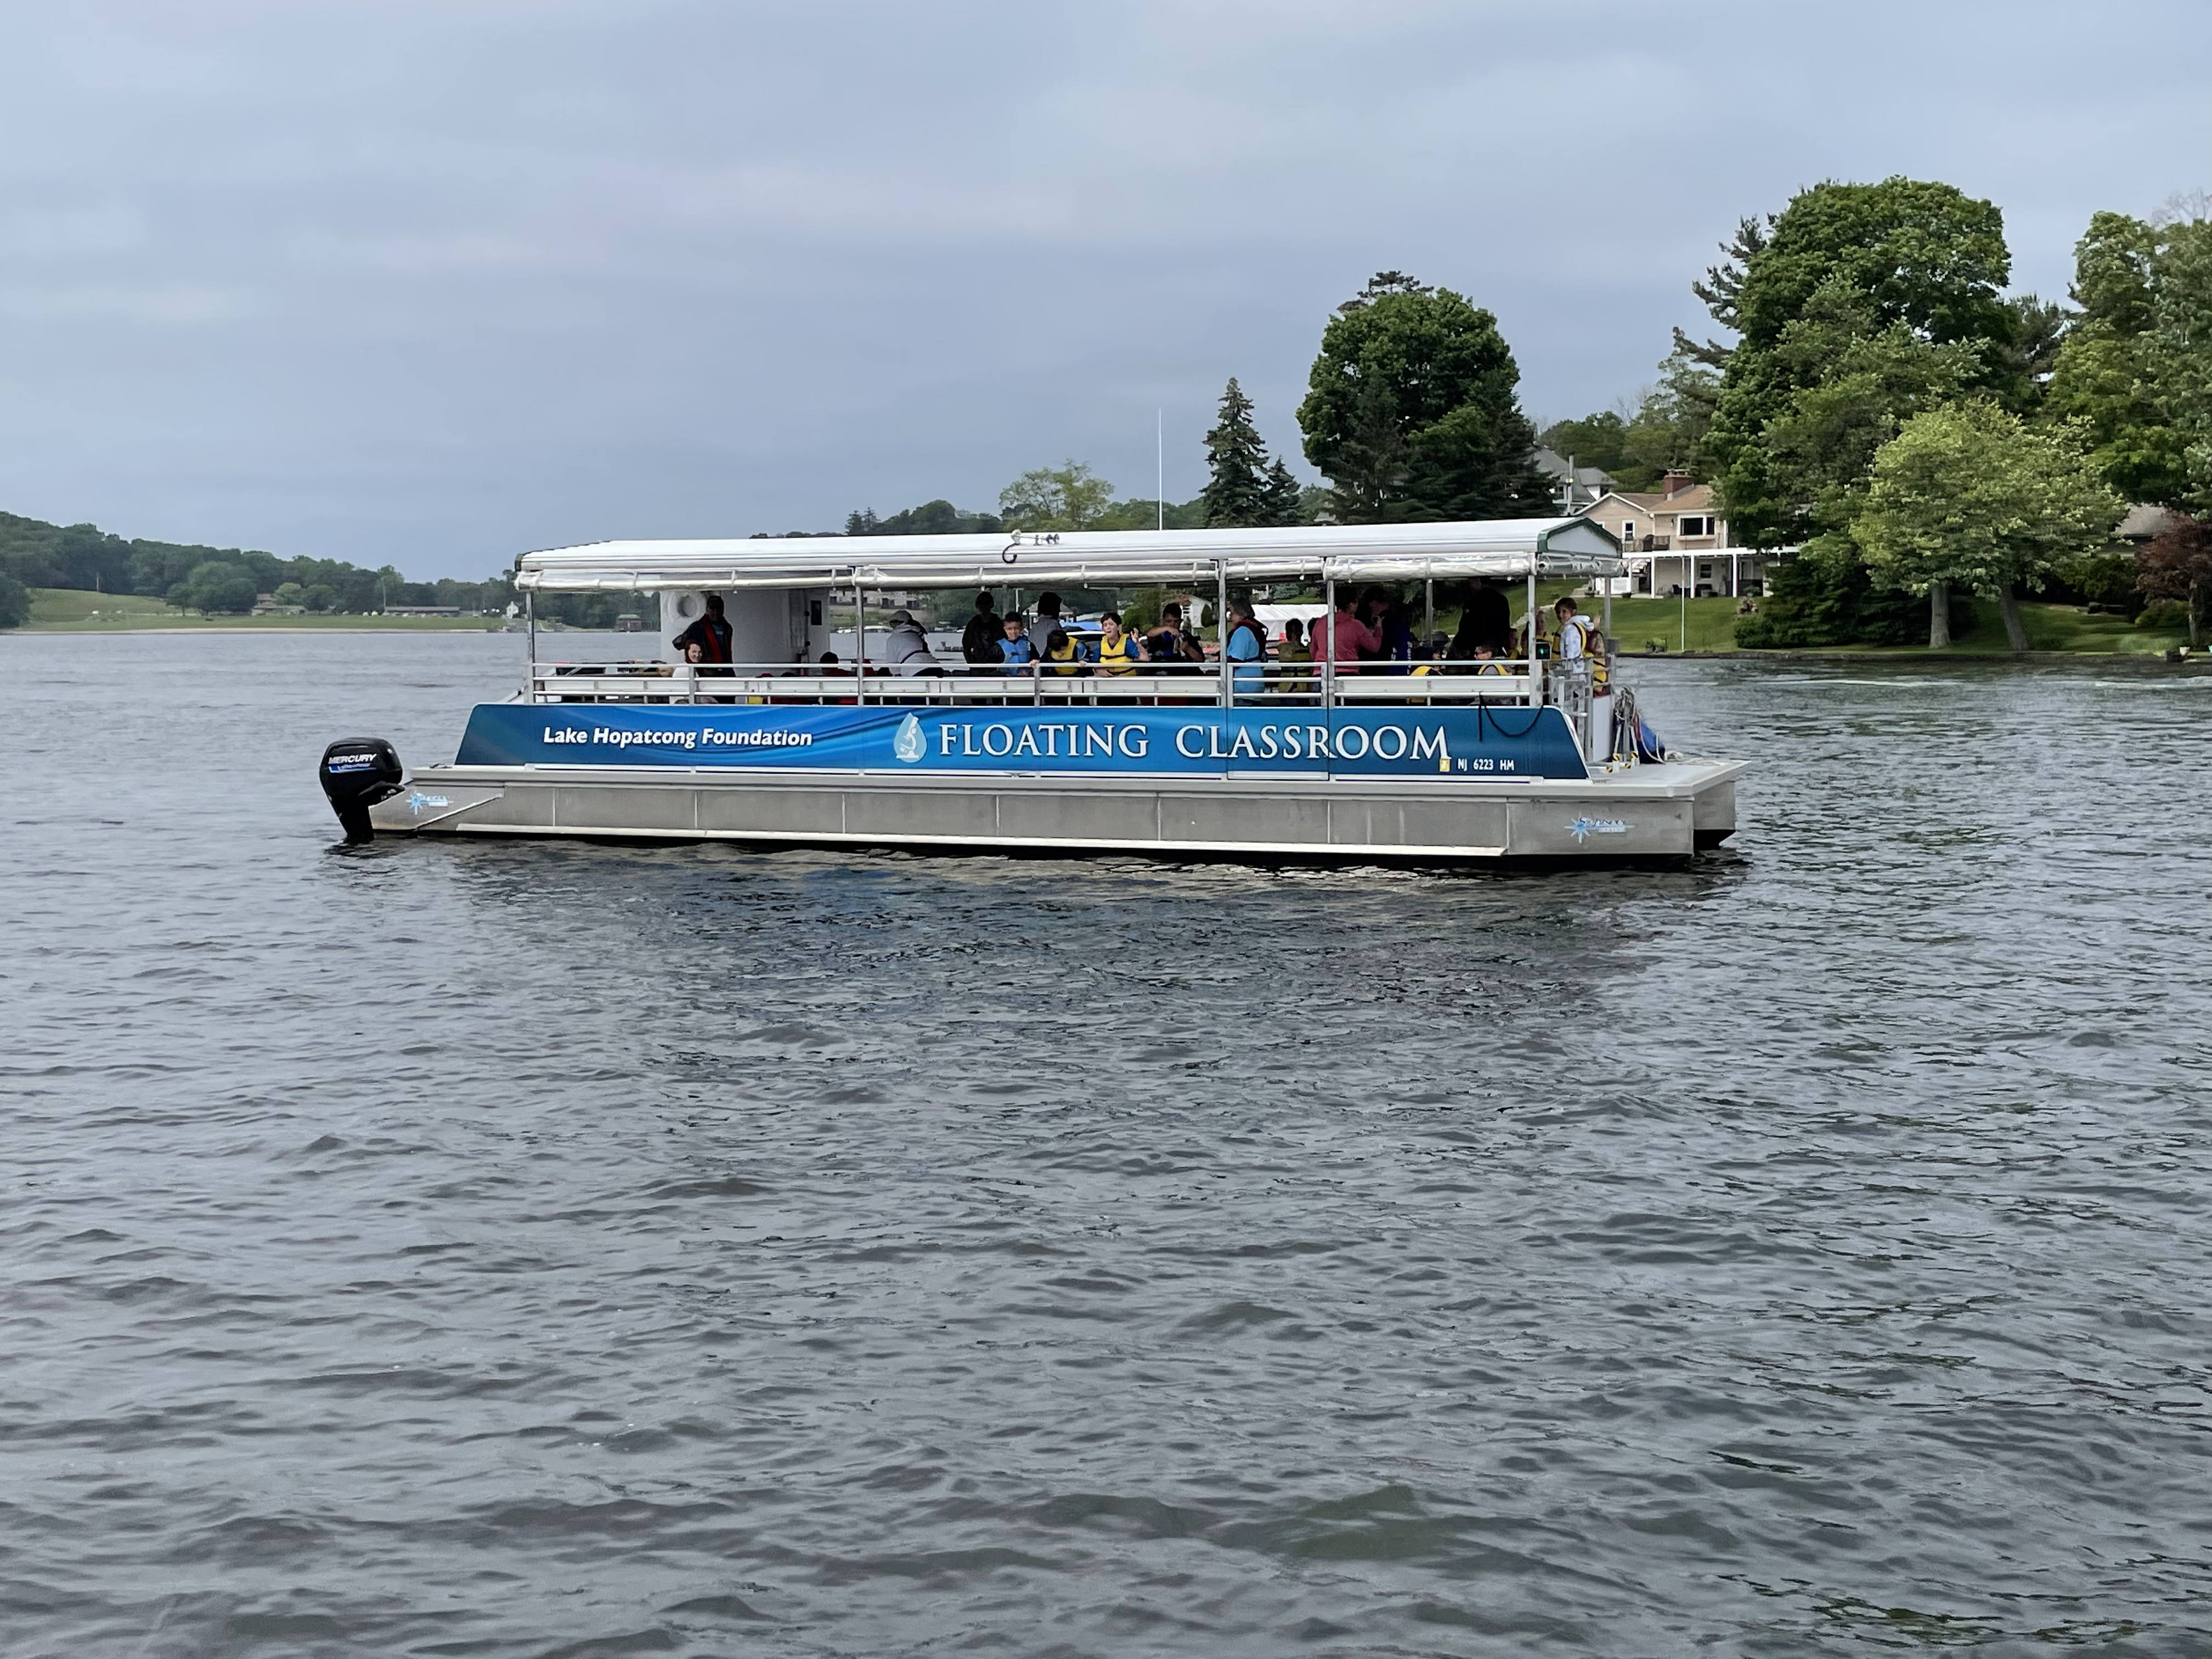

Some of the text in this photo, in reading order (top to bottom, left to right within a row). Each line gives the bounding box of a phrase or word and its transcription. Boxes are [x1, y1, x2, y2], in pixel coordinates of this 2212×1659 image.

[544, 727, 812, 748] Lake Hopatcong Foundation
[939, 724, 1452, 760] FLOATING CLASSROOM
[328, 753, 377, 764] MERCURY
[1458, 758, 1514, 771] NJ 6223 HM
